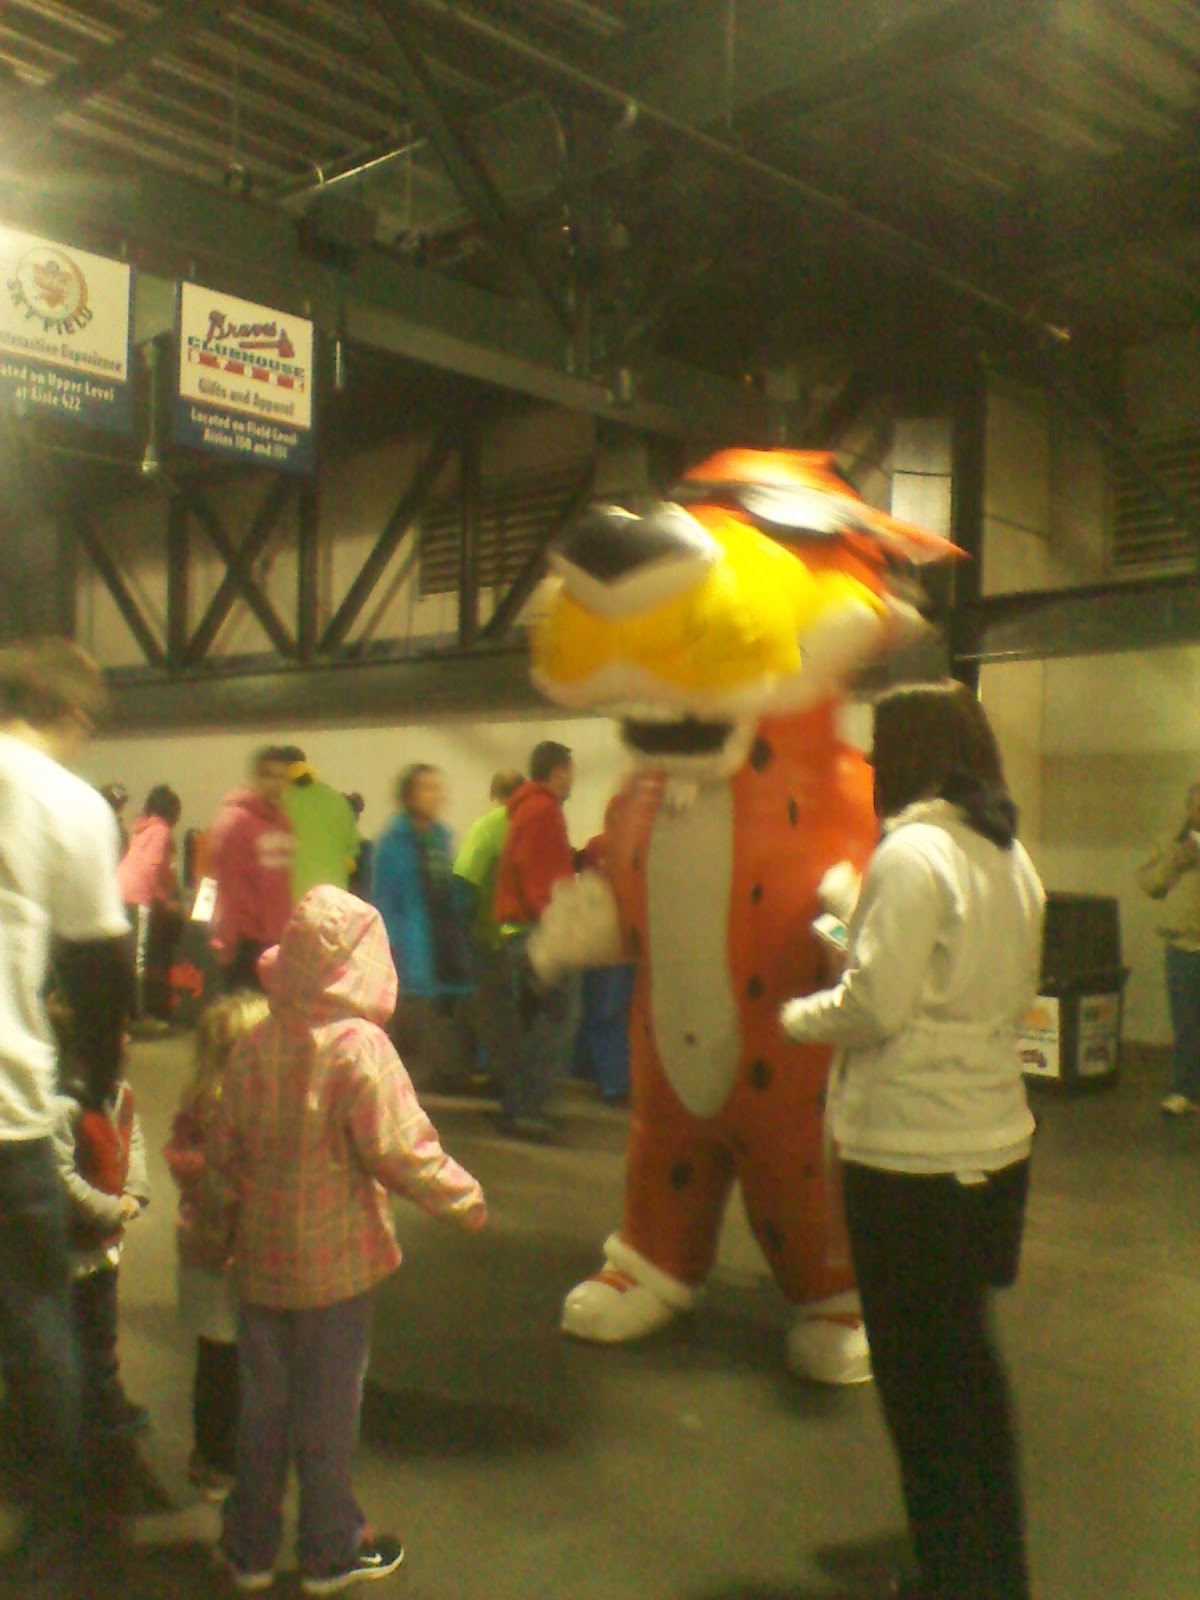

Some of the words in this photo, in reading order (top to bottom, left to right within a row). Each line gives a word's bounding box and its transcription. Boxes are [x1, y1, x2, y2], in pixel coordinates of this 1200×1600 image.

[206, 310, 278, 345] Braves
[188, 336, 305, 379] CLUBHOUSE
[47, 372, 83, 394] Upper
[84, 380, 115, 401] Level
